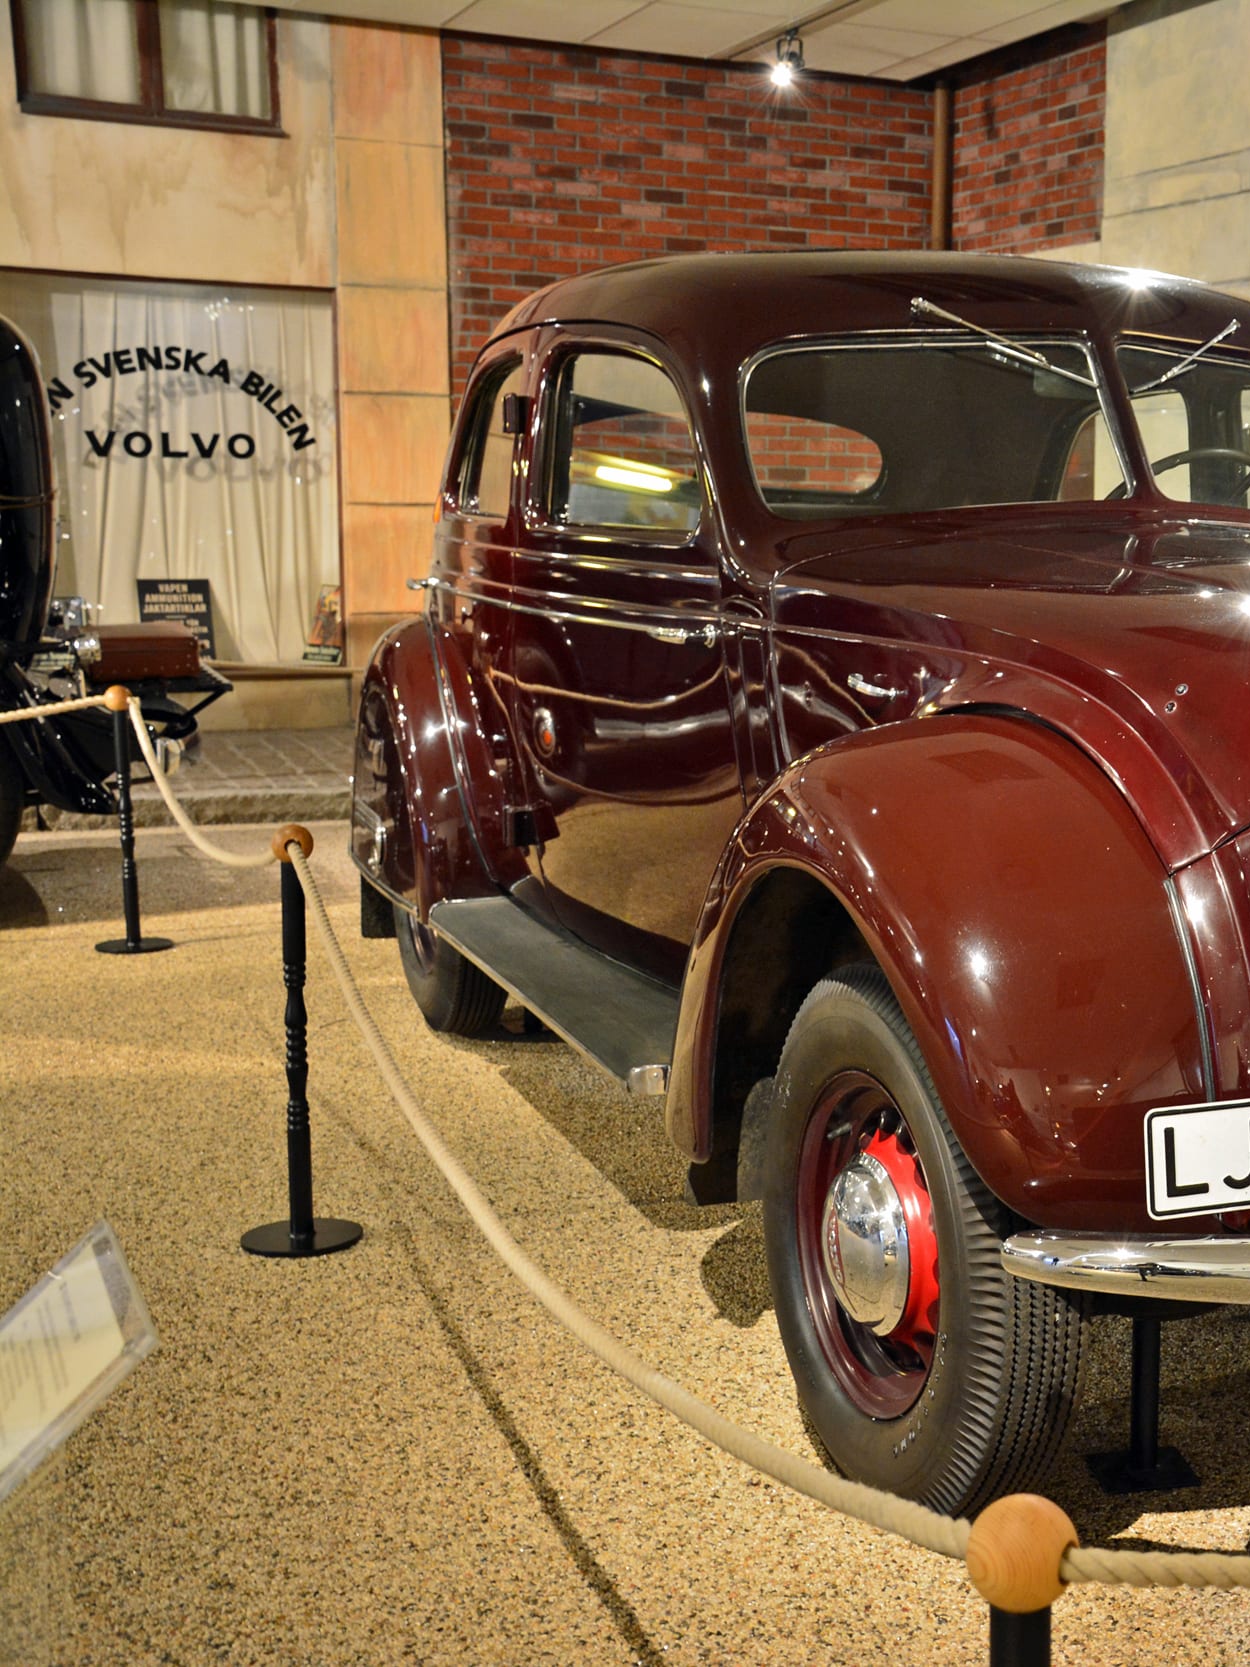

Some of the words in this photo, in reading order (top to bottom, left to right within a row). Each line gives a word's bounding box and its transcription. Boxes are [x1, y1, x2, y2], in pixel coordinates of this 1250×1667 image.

[73, 346, 231, 389] SVENSKA
[239, 371, 317, 451] BILEN
[84, 430, 256, 459] VOLVO
[145, 593, 203, 603] AMMUNITION
[158, 583, 188, 593] VAPEN
[829, 1215, 844, 1284] VOLVO
